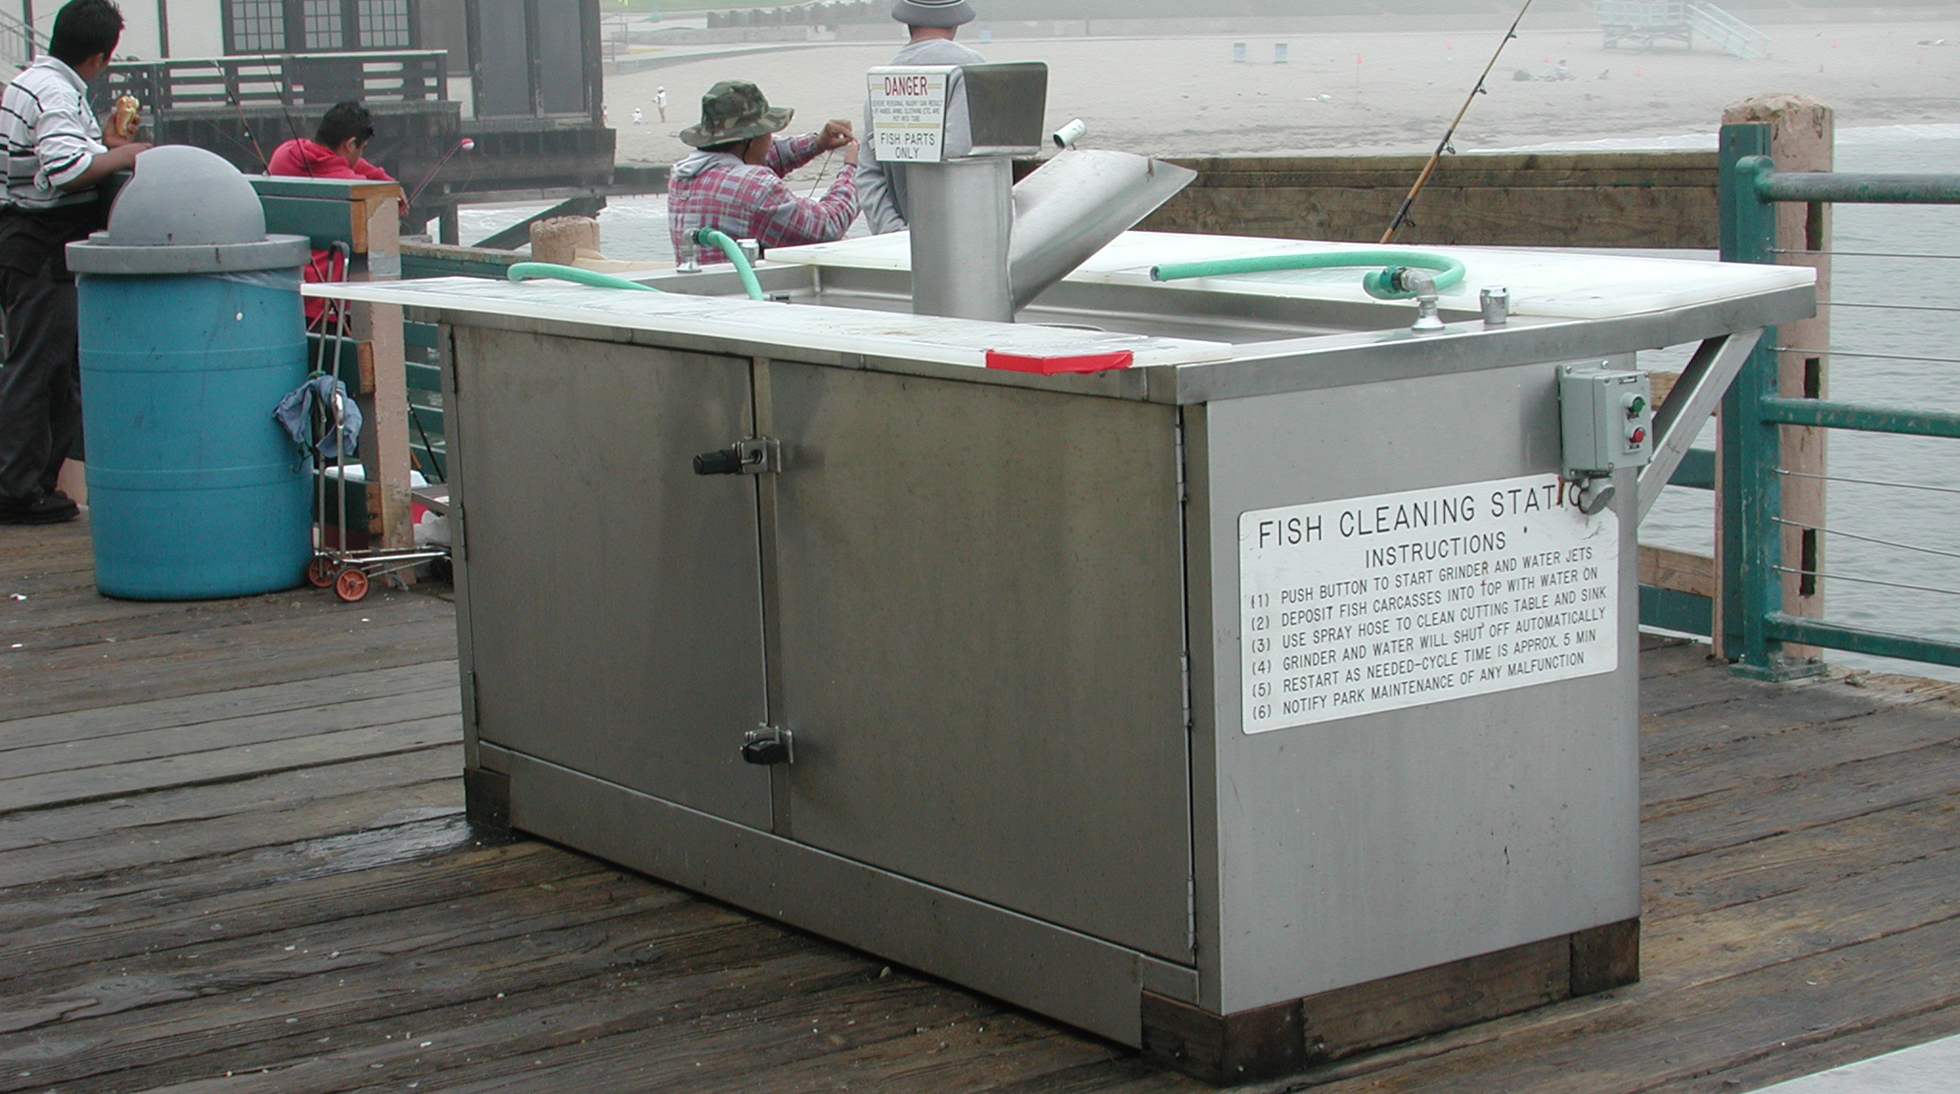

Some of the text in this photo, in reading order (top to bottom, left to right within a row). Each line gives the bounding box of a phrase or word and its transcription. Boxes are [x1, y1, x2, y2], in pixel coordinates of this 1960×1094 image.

[885, 76, 928, 96] DANGER
[881, 132, 935, 146] FISH PARTS
[895, 146, 919, 159] ONLY
[1258, 480, 1584, 548] FISH CLEANING STATIO
[1250, 546, 1593, 609] (1) PUSH BUTTON TO START GRINDER AND WATER JETS
[1365, 530, 1507, 568] INSTRUCTIONS
[1251, 566, 1598, 631] (2) DEPOSIT FISH CARCASSES INTO TOP WITH WATER ON
[1251, 585, 1607, 653] (3) USE SPRAY HOSE TO CLEAN CUTTING TABLE AND SINK
[1251, 606, 1606, 675] (4) GRINDER AND WATER WILL SHUT OFF AUTOMATICALLY
[1252, 681, 1272, 698] (5)
[1282, 670, 1340, 692] RESTART
[1344, 666, 1362, 683] AS
[1463, 645, 1493, 662] TIME
[1497, 642, 1509, 657] IS
[1563, 632, 1571, 646] 5
[1575, 628, 1596, 643] MIN
[1252, 651, 1584, 720] (6) NOTIFY PARK MAINTENANCE OF ANY MALFUNCTION
